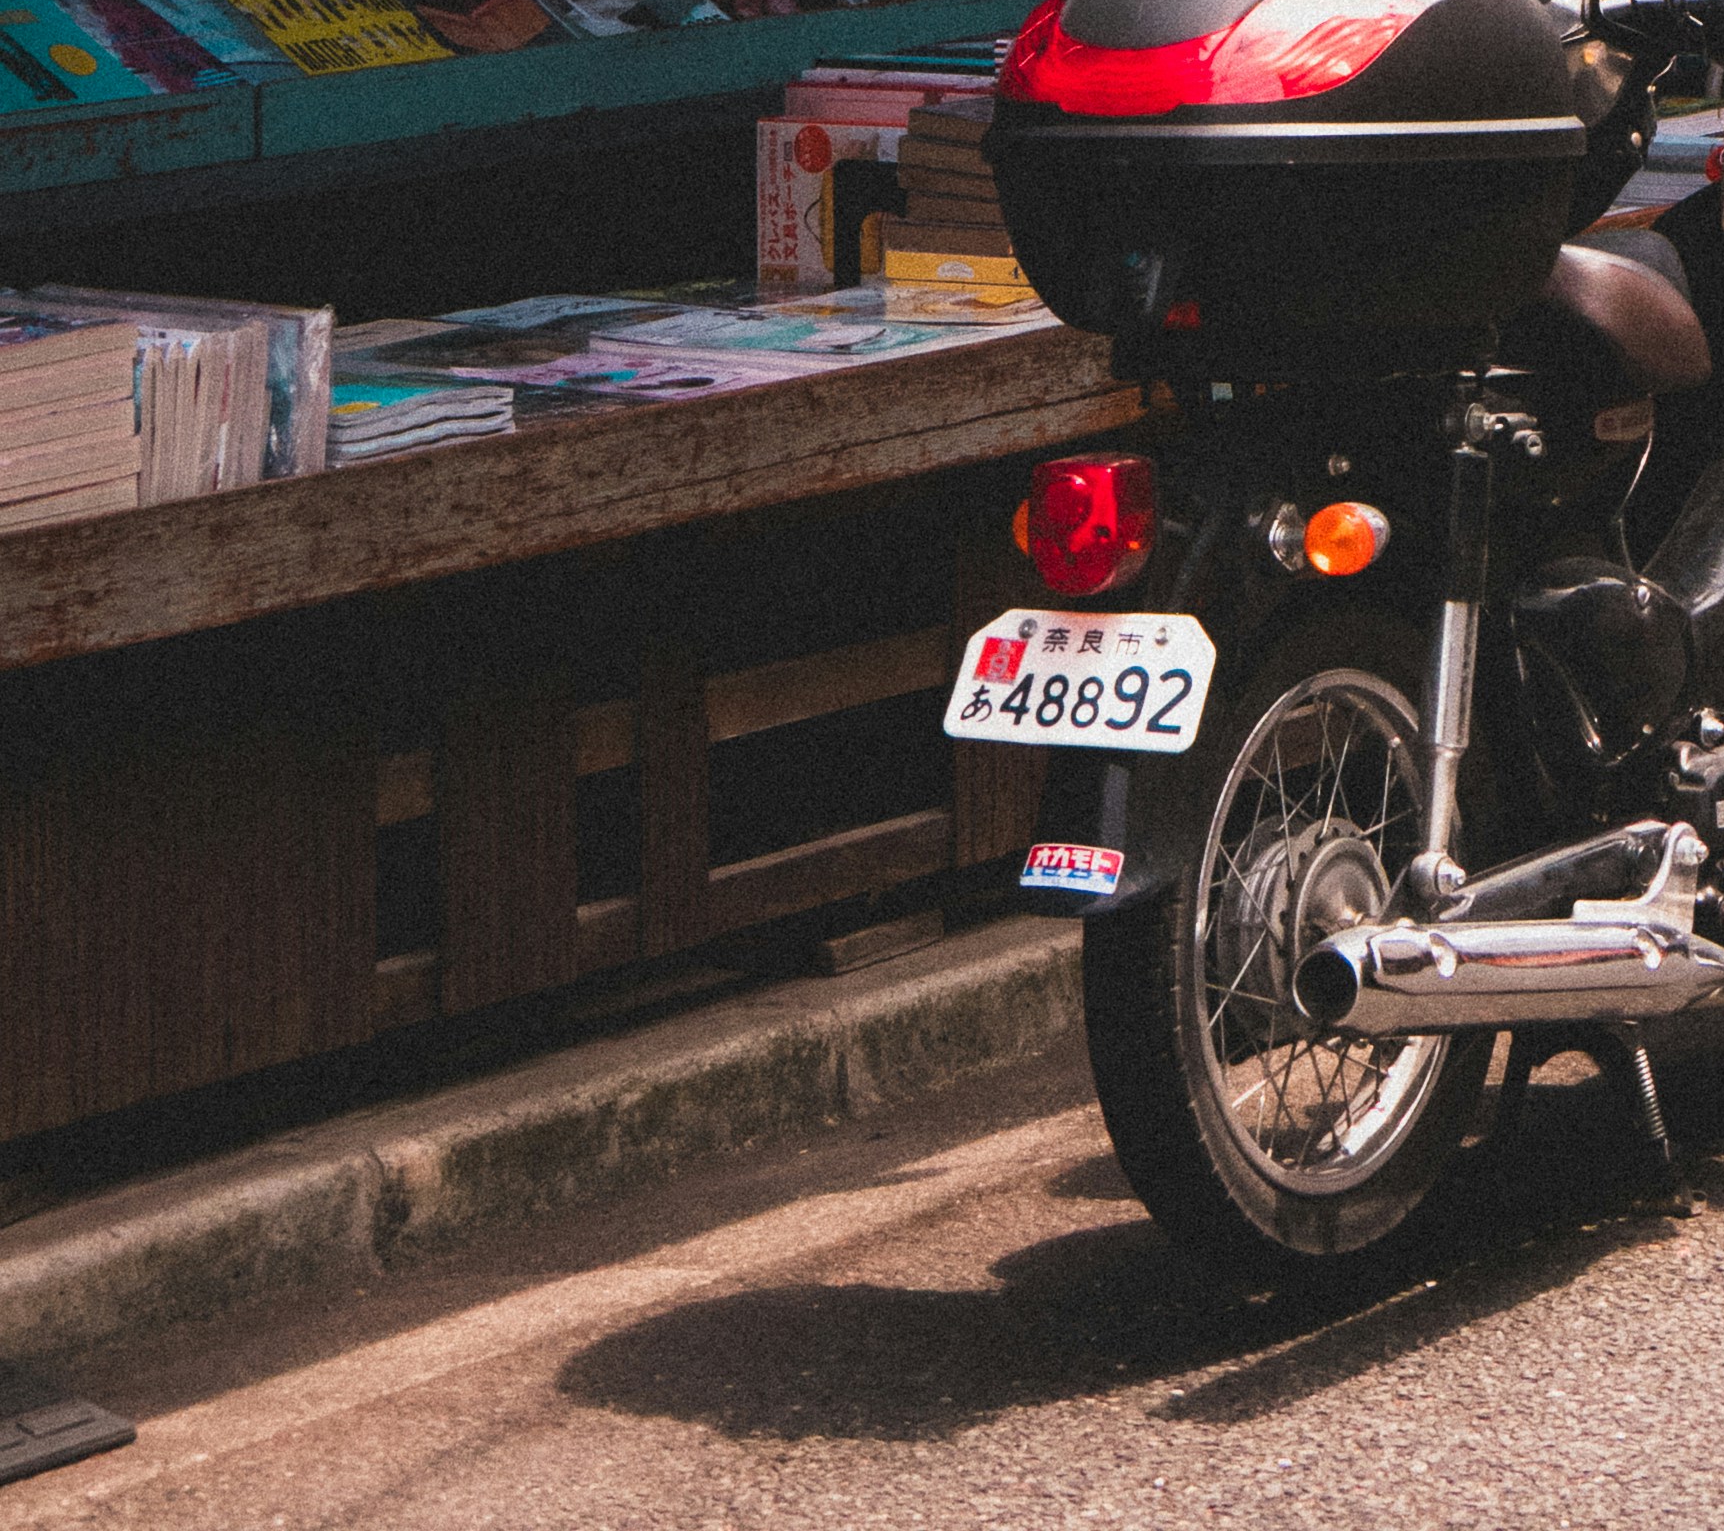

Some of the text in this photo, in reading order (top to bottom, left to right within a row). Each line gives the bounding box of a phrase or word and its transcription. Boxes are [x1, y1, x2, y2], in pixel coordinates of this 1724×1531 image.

[1041, 627, 1144, 657] 奈良市
[959, 684, 993, 723] あ
[1033, 847, 1112, 872] オカモト
